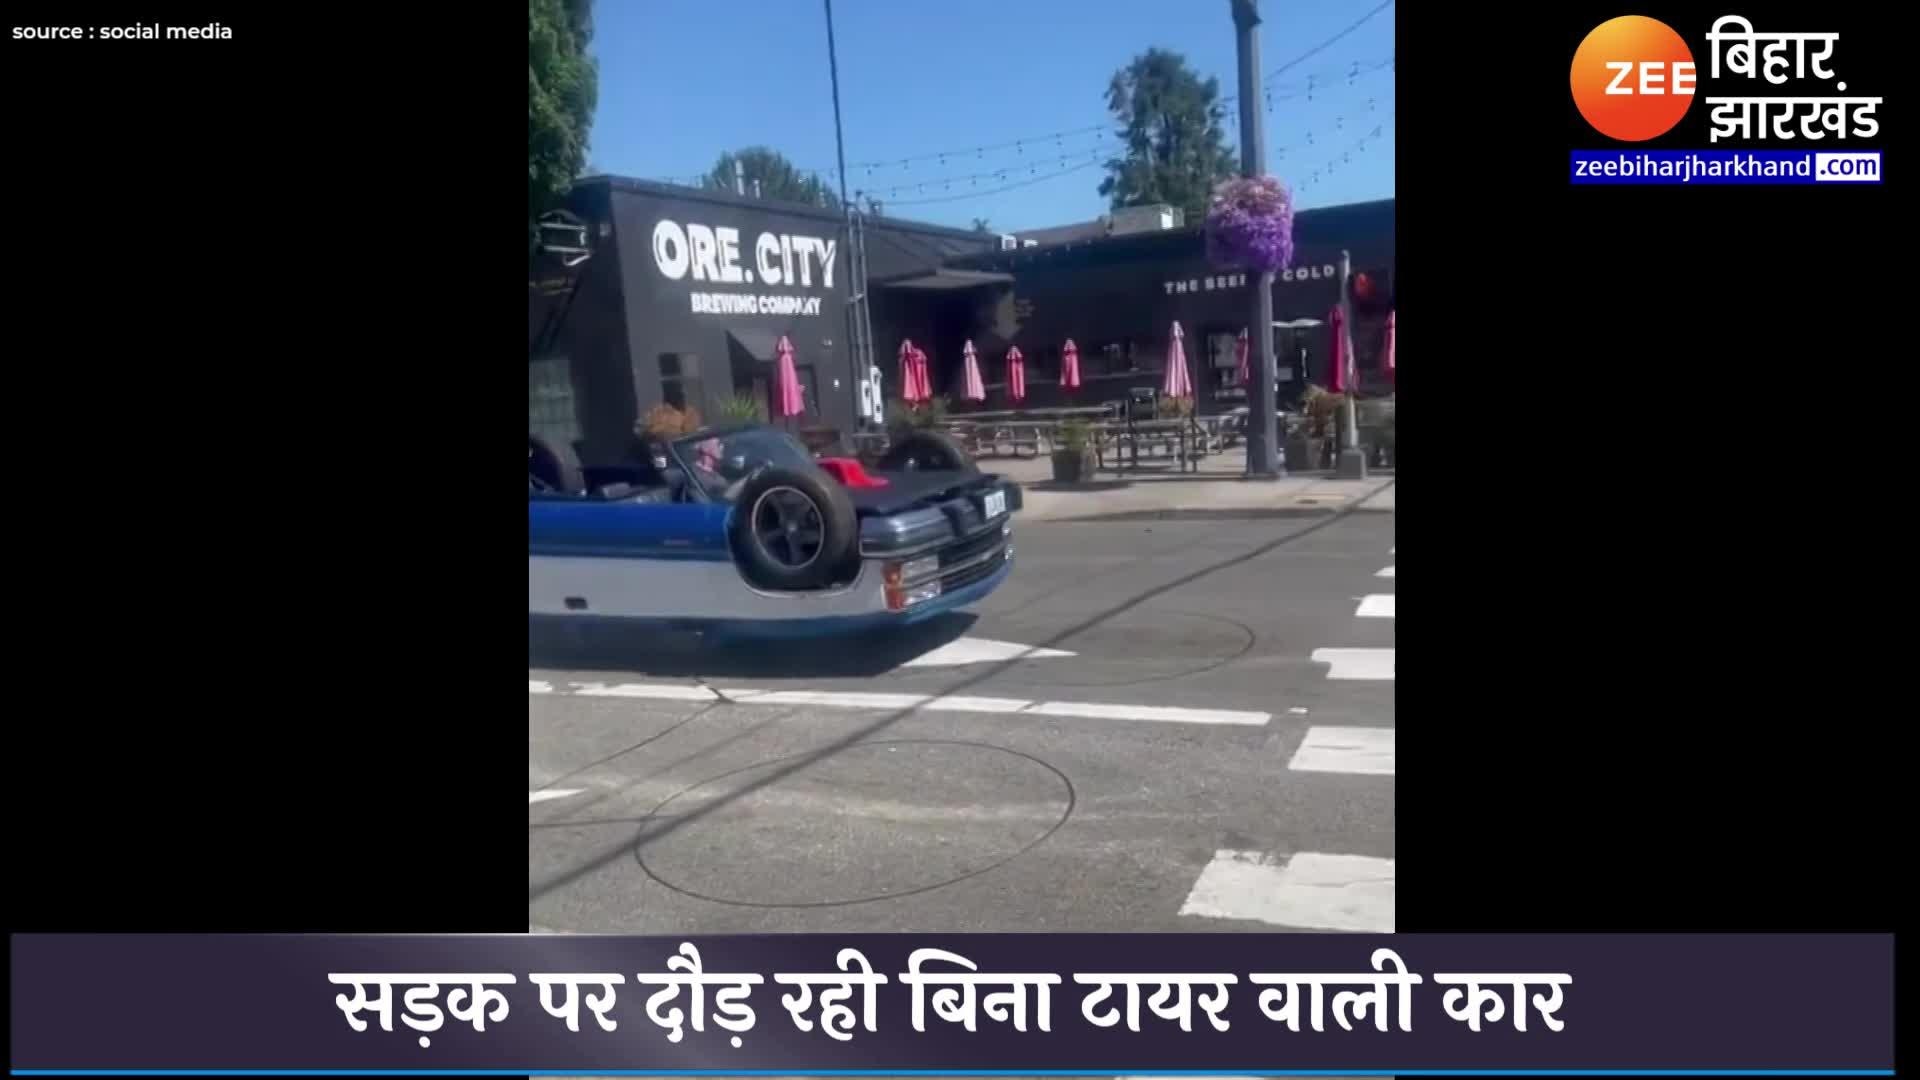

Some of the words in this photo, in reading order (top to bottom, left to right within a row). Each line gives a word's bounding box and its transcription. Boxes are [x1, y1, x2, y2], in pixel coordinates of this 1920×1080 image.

[755, 231, 836, 288] CITY
[1164, 279, 1199, 294] THE
[1281, 264, 1336, 281] COLD
[690, 292, 758, 314] BREWING
[759, 295, 822, 316] COMPANY
